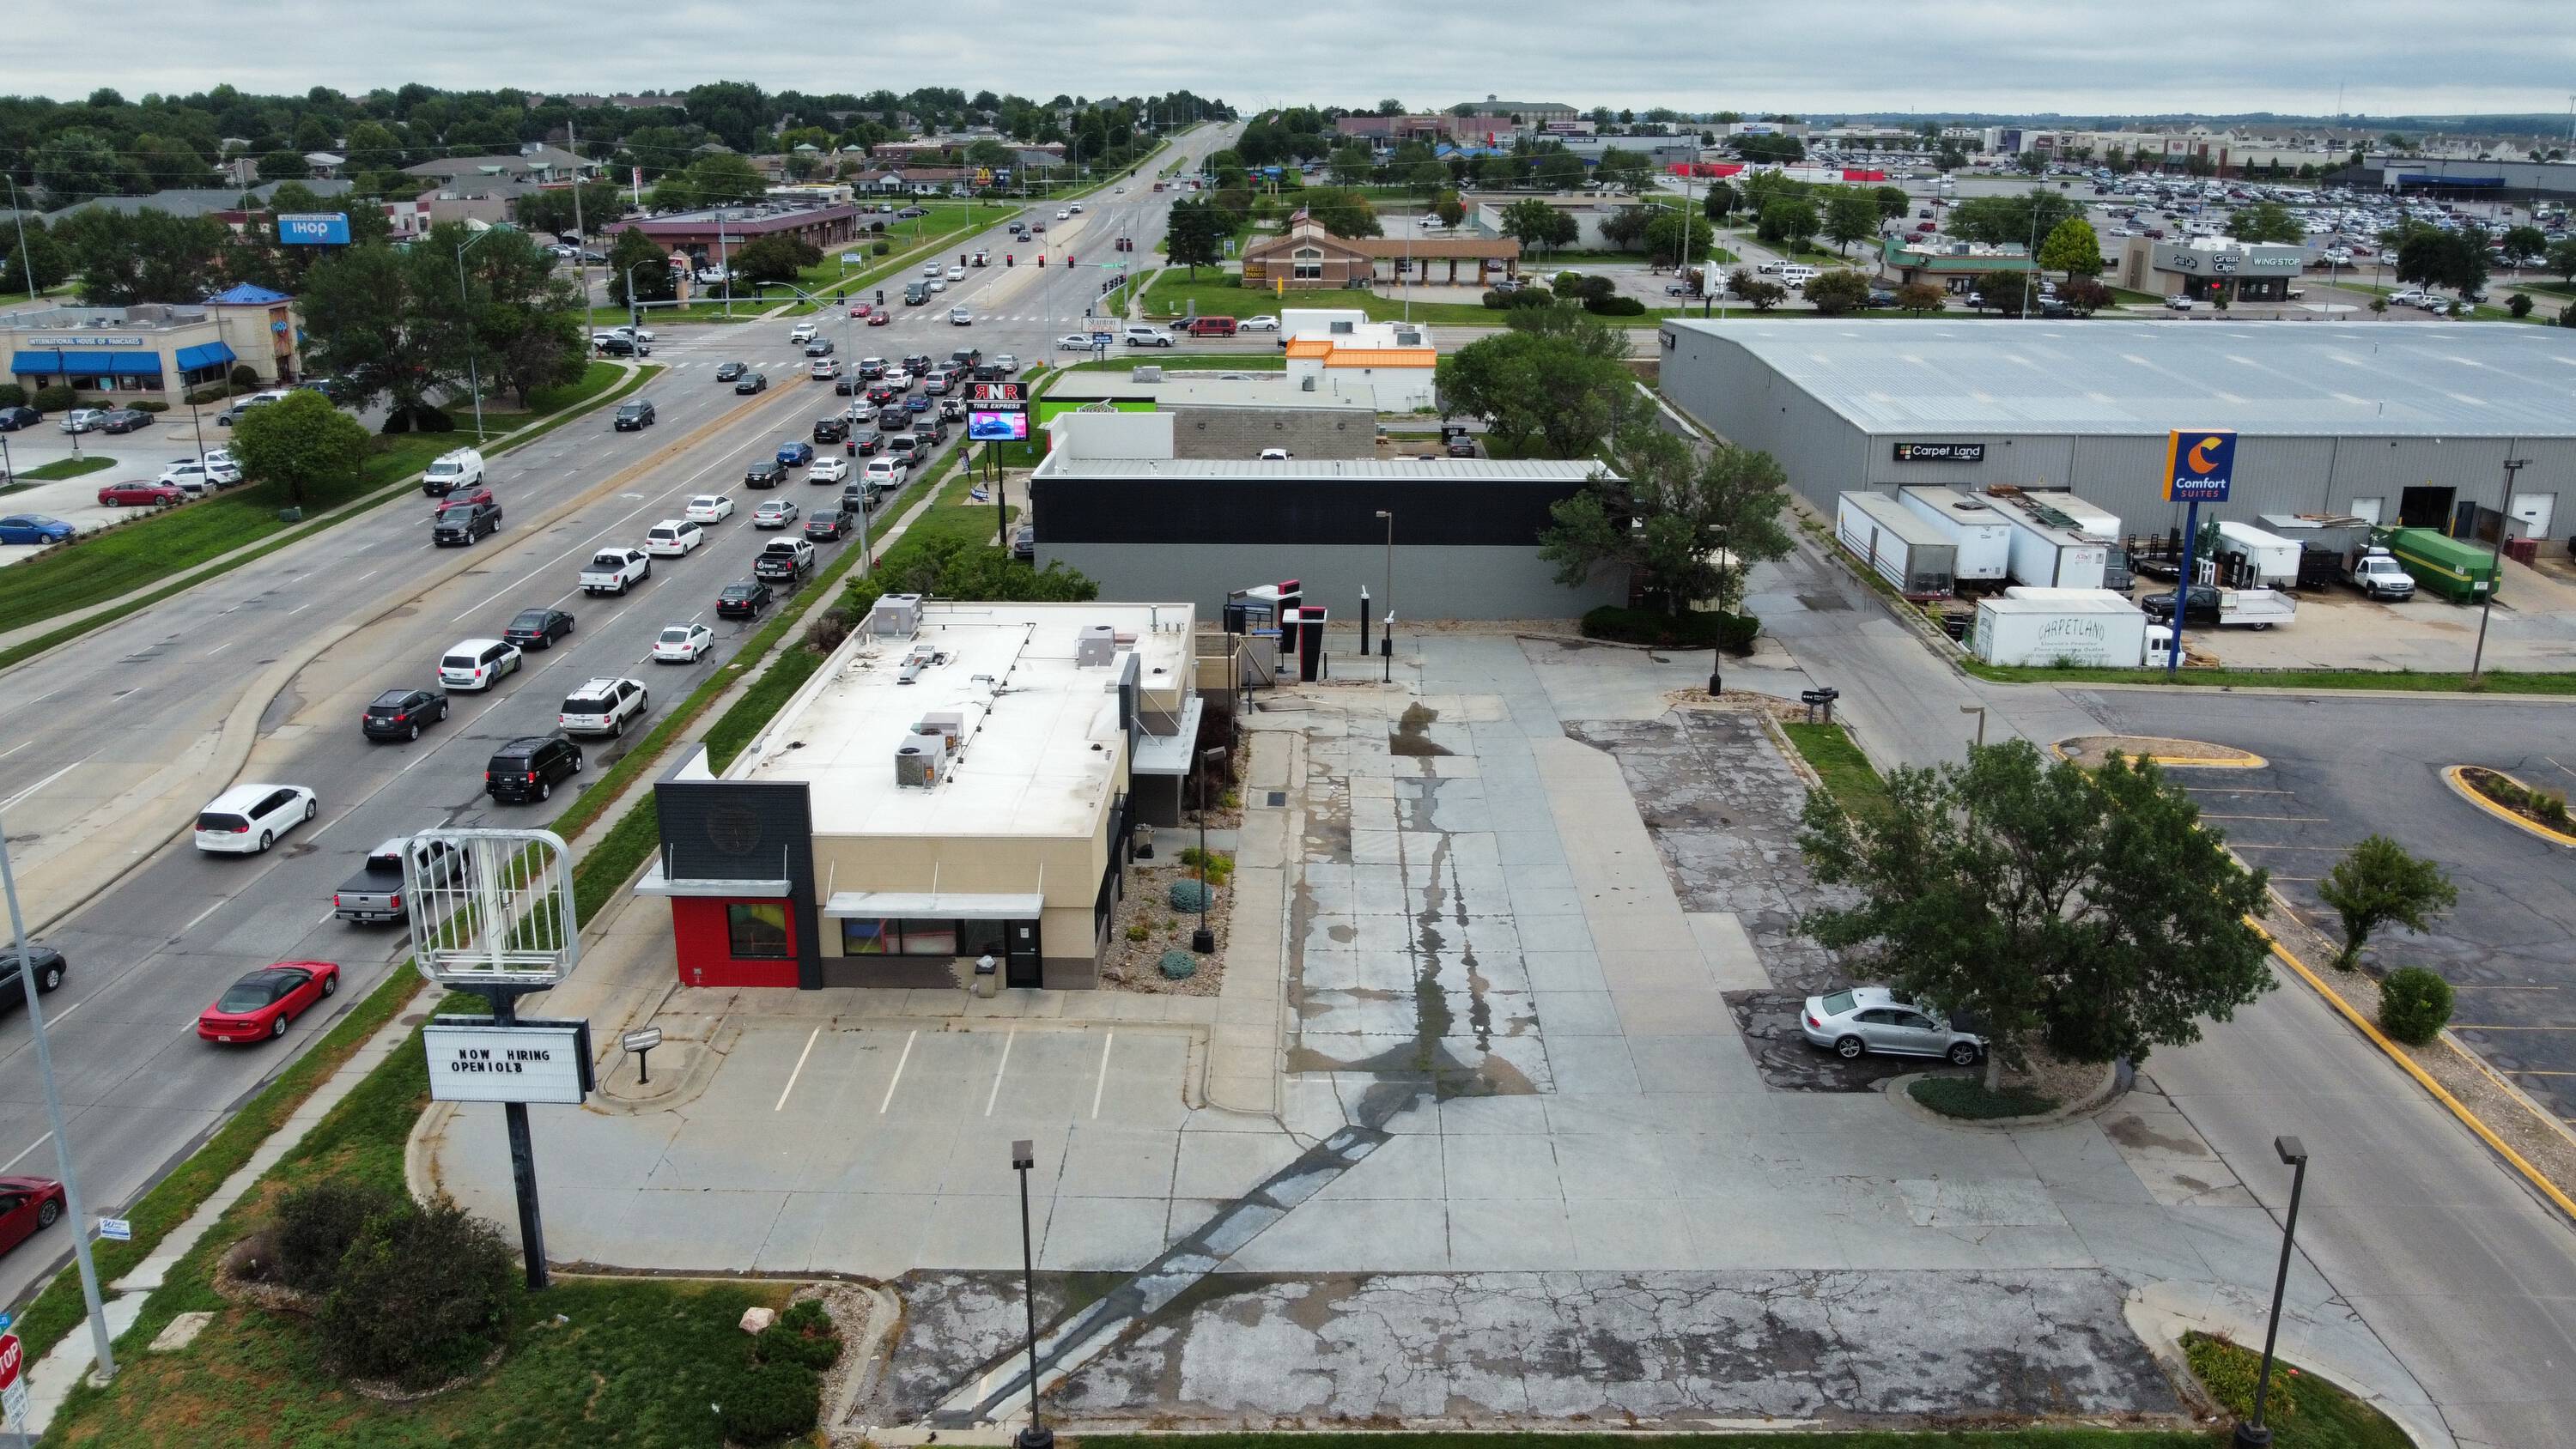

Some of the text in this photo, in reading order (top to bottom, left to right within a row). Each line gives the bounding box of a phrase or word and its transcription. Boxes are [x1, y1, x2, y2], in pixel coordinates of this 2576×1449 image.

[2213, 254, 2239, 264] Great
[2215, 263, 2236, 273] Clips
[1912, 446, 1980, 457] Carpet Land
[2176, 477, 2227, 488] Comfort
[459, 1049, 550, 1061] NOW HIRING
[0, 1342, 19, 1375] TOP
[3, 1380, 22, 1405] RIGHT
[8, 1393, 25, 1414] TURN
[10, 1404, 27, 1426] ONLY
